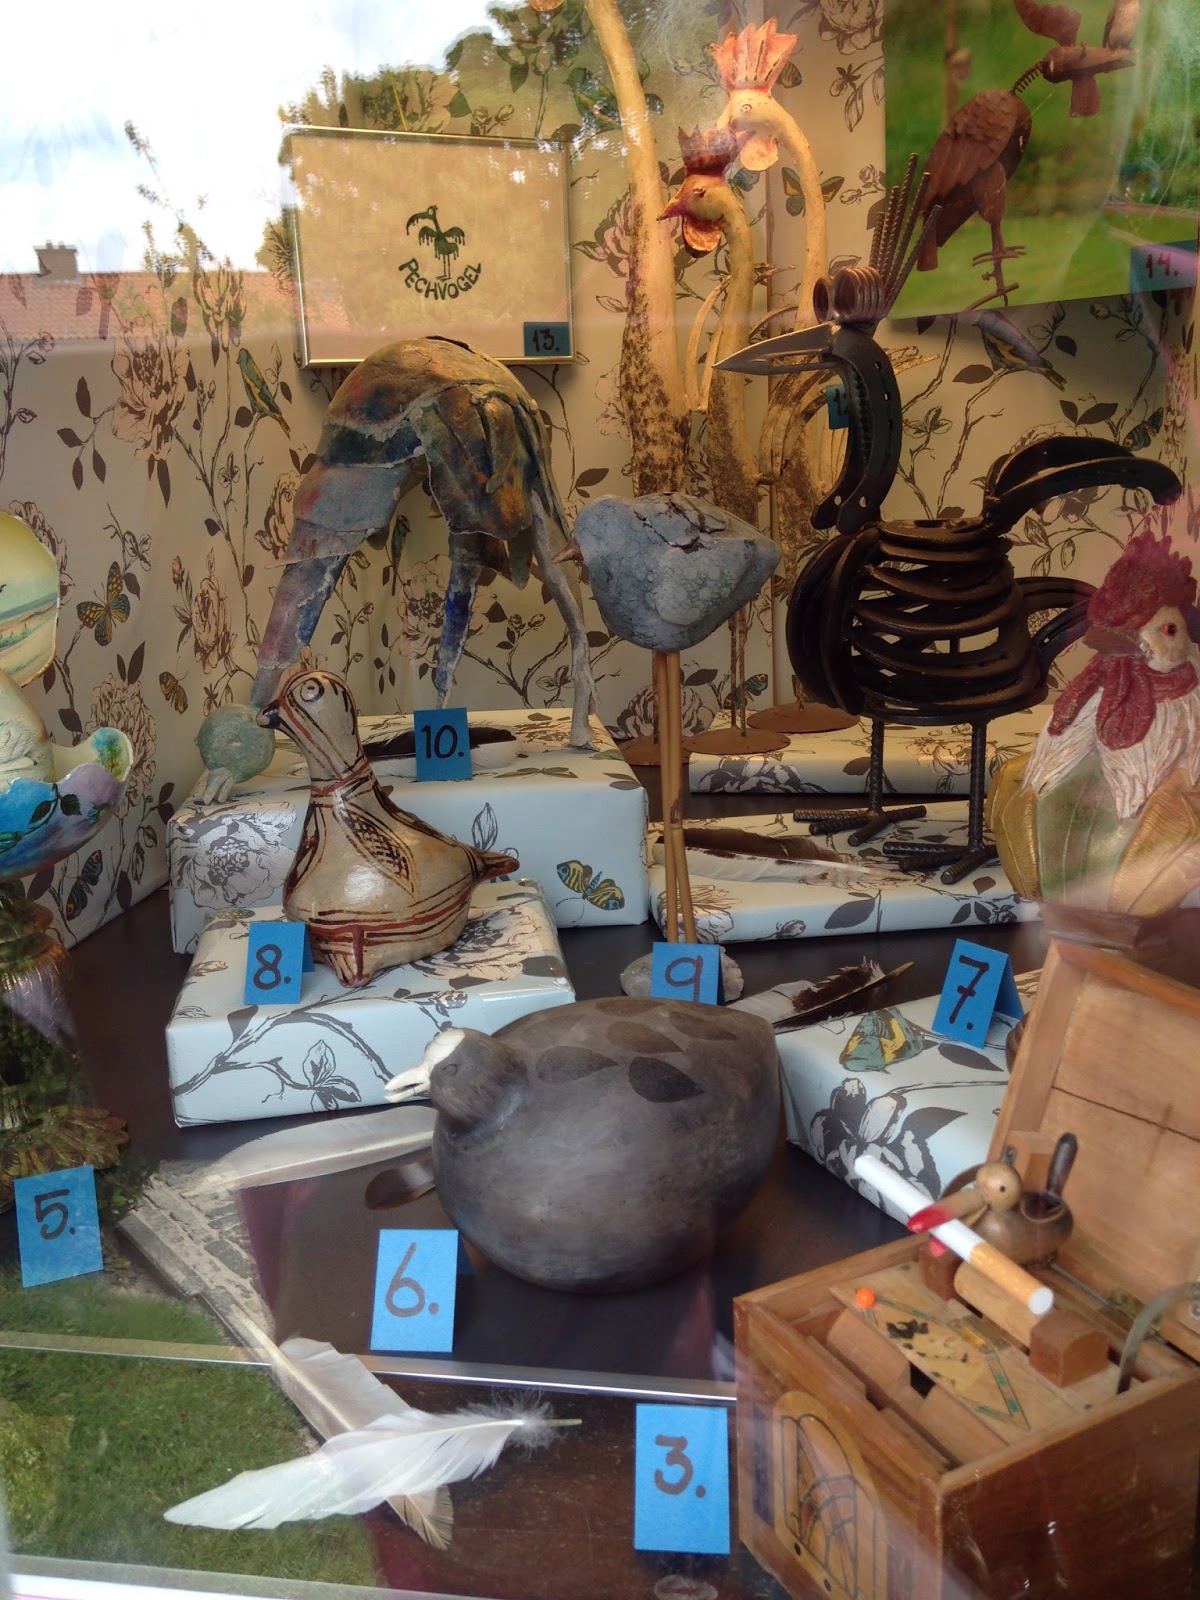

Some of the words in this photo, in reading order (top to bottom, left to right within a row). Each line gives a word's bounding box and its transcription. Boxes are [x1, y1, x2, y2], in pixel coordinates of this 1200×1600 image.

[398, 257, 482, 300] PECHVOGEL
[1145, 252, 1179, 279] 14.
[532, 328, 560, 352] 13.
[421, 724, 465, 759] 10.
[253, 944, 292, 991] 8.
[664, 956, 704, 1002] 9
[949, 954, 990, 1031] 7.
[35, 1189, 76, 1240] 5.
[385, 1242, 440, 1318] 6.
[654, 1434, 706, 1498] 3.
